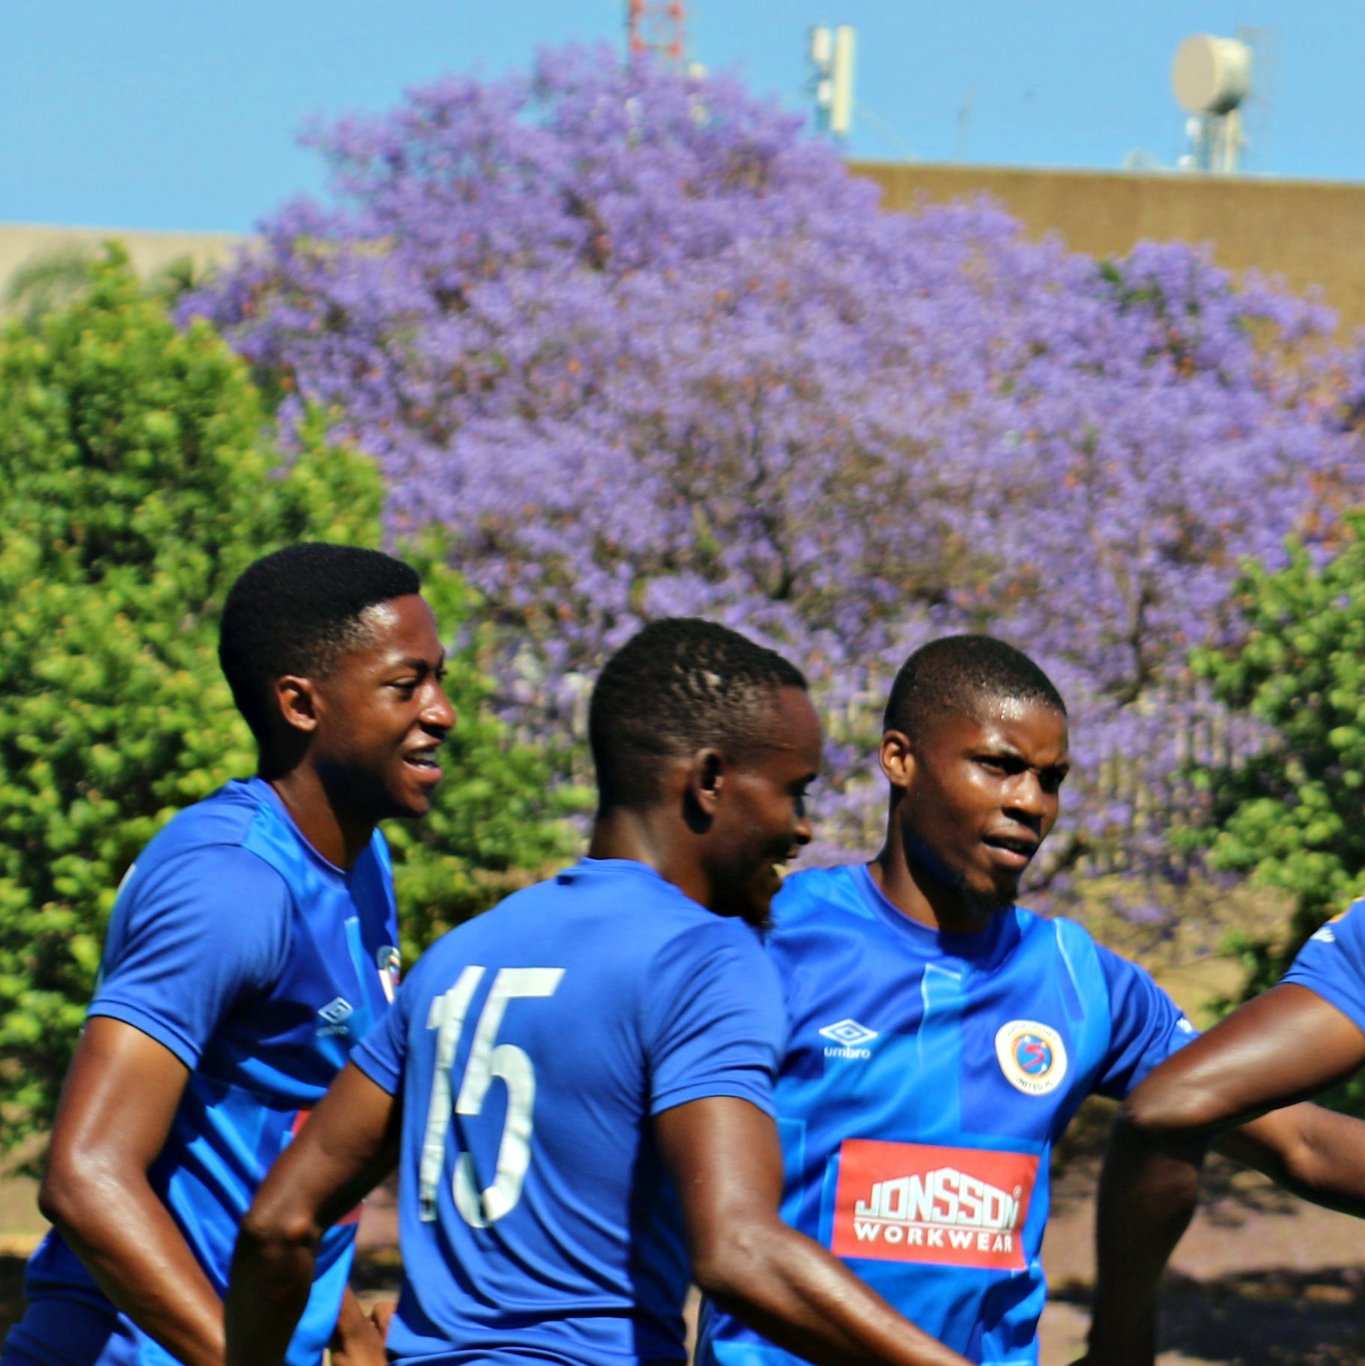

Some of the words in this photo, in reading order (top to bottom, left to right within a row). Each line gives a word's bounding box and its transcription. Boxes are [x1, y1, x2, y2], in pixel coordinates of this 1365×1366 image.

[418, 965, 567, 1229] 15
[854, 1166, 1020, 1229] JONSSON
[853, 1220, 1014, 1254] WORKWEAR
